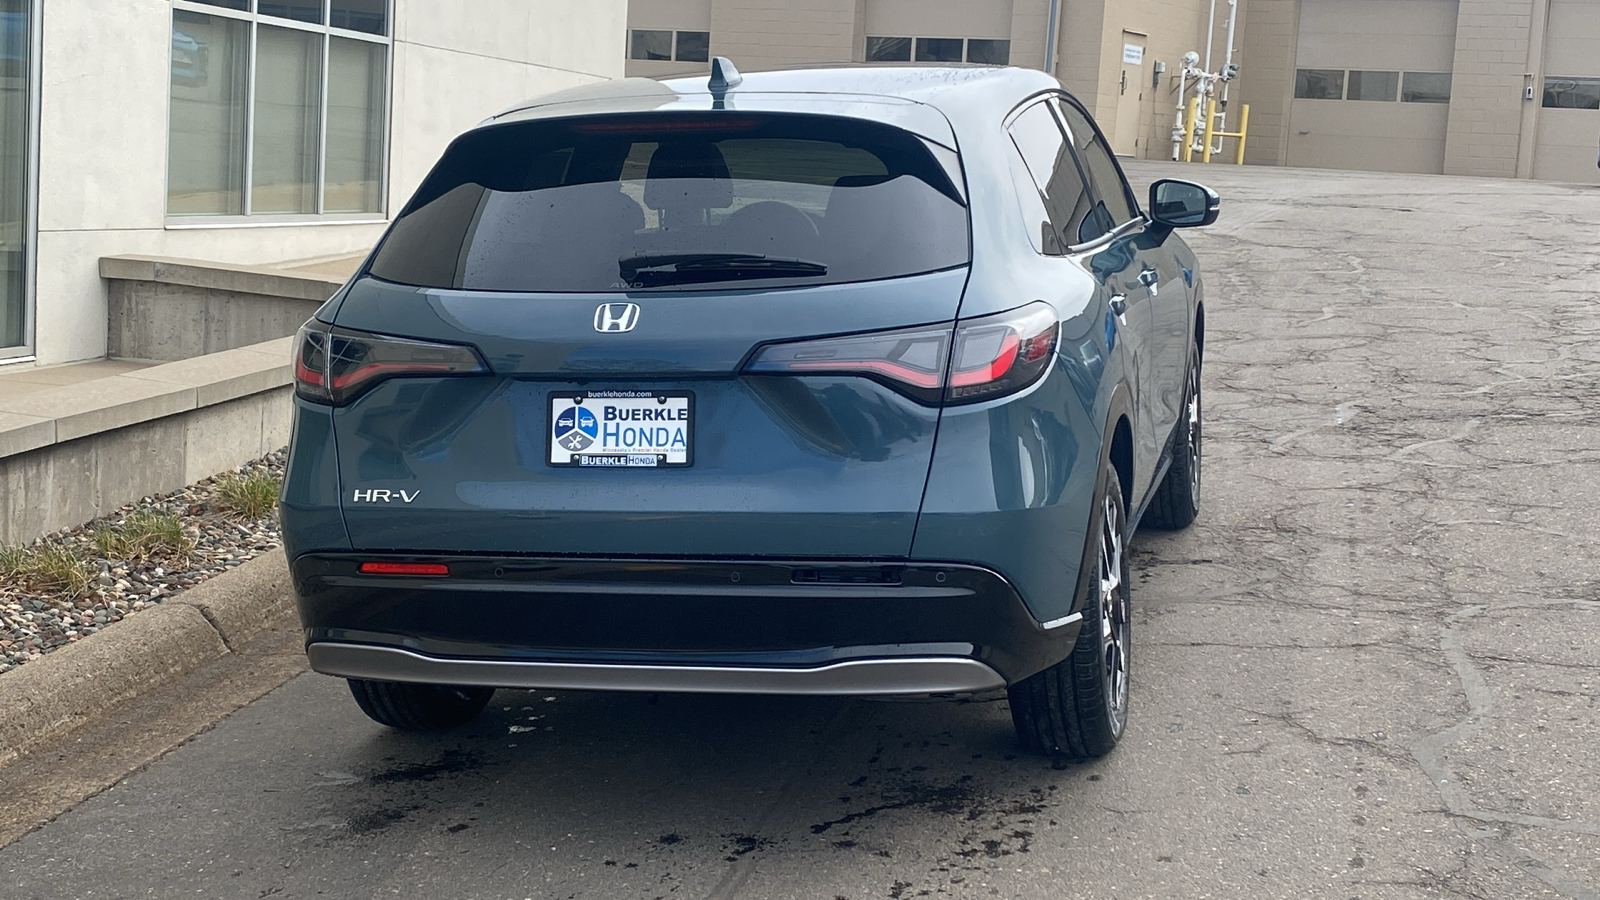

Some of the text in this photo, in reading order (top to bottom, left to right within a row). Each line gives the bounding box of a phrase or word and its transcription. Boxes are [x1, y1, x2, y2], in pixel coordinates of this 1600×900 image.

[588, 390, 652, 398] buerklehonda.com
[603, 405, 688, 421] BUERKLE
[602, 422, 687, 448] HONDA
[353, 489, 421, 503] HR-V
